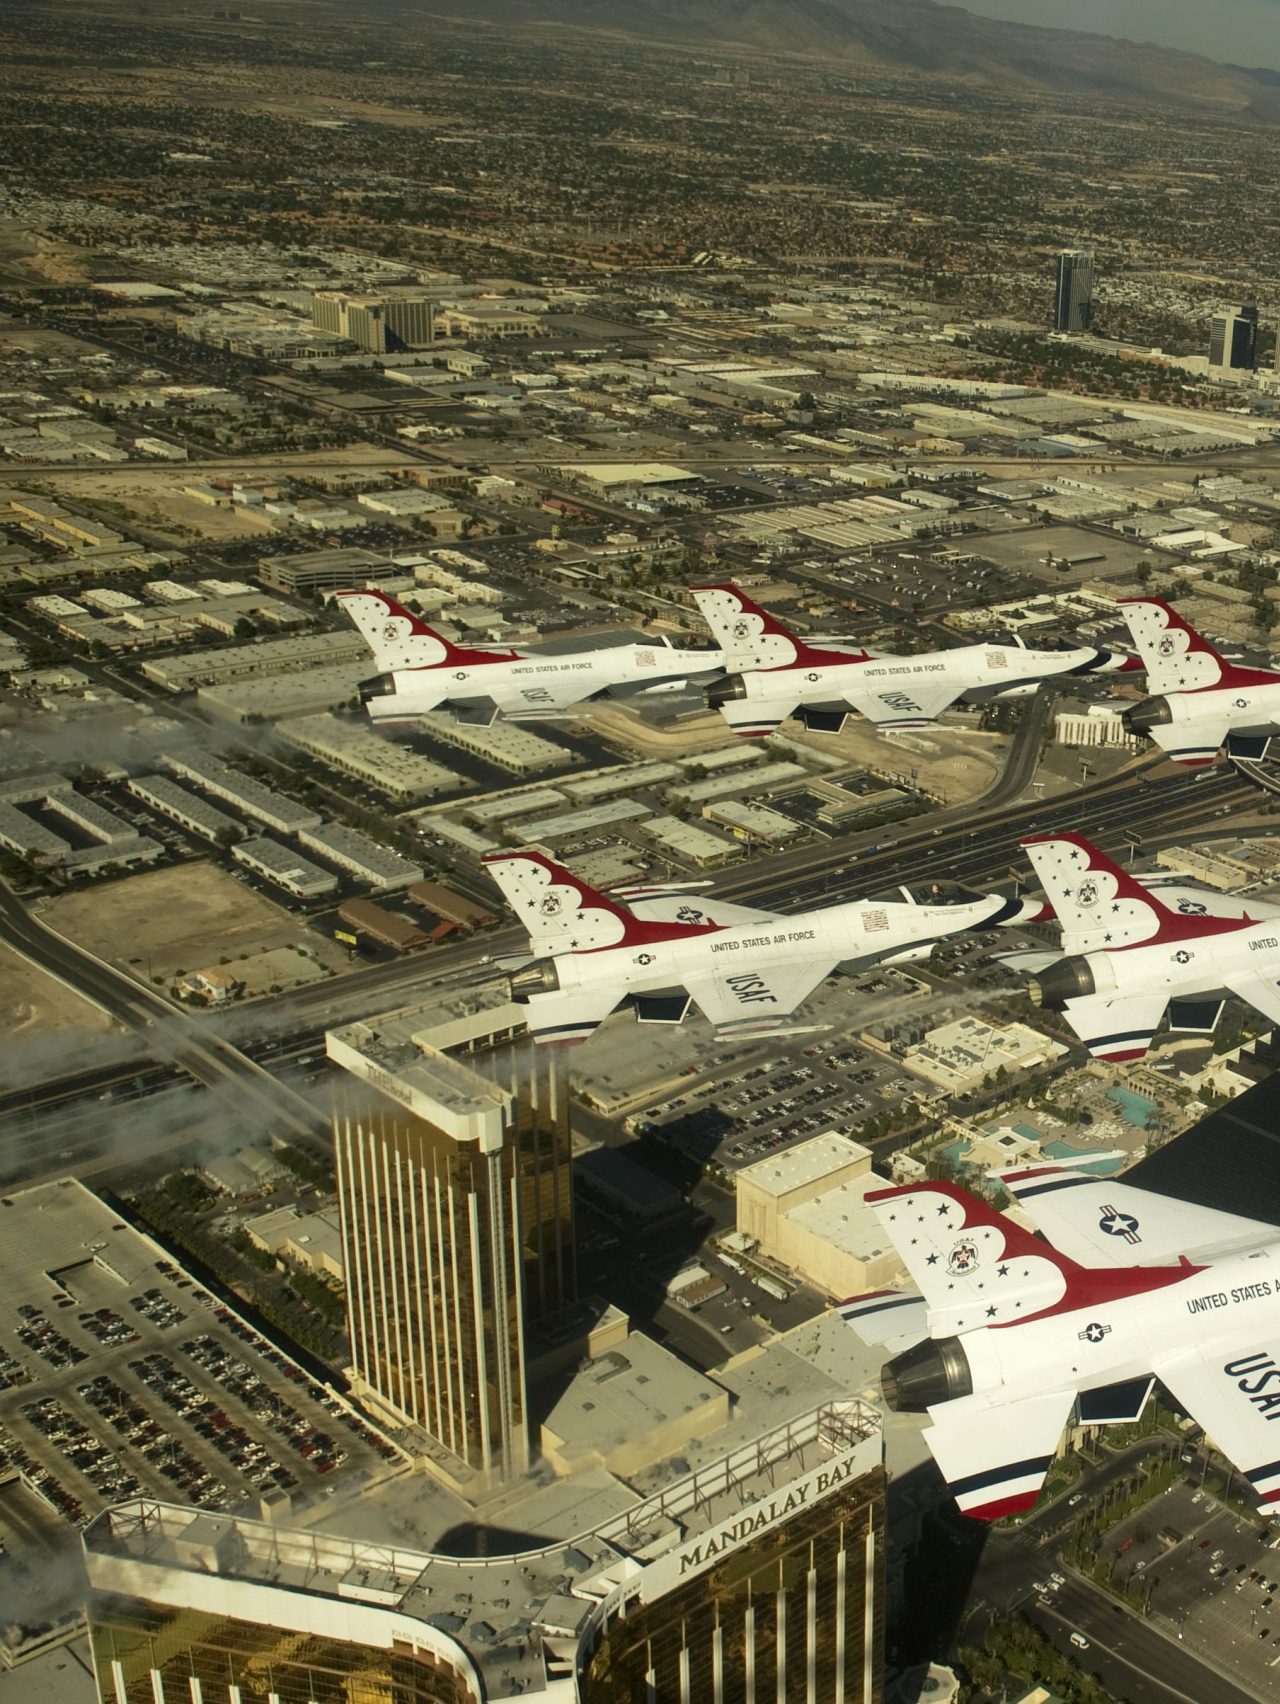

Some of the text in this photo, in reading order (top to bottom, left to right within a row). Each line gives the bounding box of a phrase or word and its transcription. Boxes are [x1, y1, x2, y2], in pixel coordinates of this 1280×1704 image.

[536, 664, 558, 673] STATES
[560, 663, 570, 671] AIR
[863, 663, 946, 677] UNITED STATES AIR FORCE
[520, 687, 555, 703] USAF
[878, 691, 923, 712] USAF
[710, 930, 816, 953] UNITED STATES AIR FORCE
[1248, 937, 1278, 951] UNITED
[726, 973, 778, 1003] USAF
[1186, 1292, 1228, 1314] UNITED
[1230, 1281, 1272, 1304] STATES
[678, 1455, 857, 1576] MANDALAY BAY
